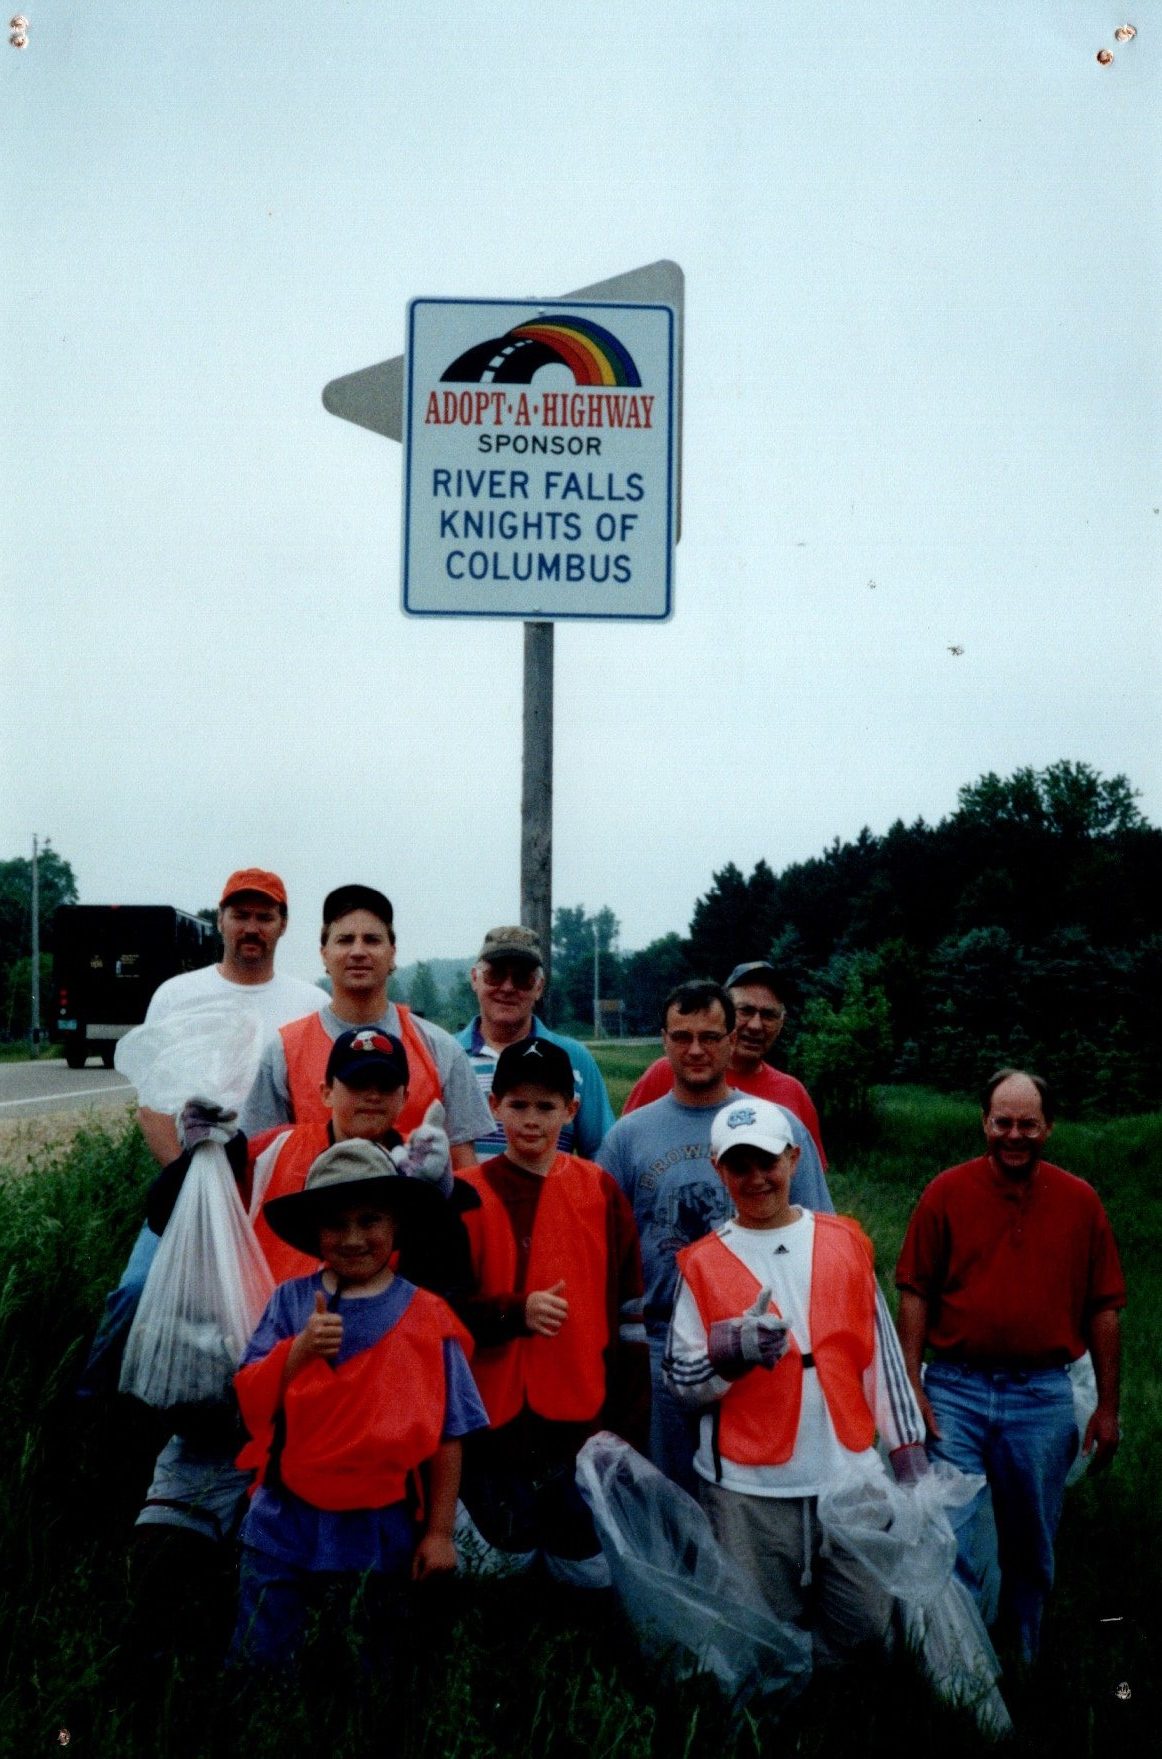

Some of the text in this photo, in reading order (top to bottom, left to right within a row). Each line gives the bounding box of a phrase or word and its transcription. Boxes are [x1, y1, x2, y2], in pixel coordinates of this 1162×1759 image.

[478, 434, 602, 455] SPONSOR
[433, 469, 644, 501] RIVER FALLS
[440, 510, 638, 541] KNIGHTS OF
[446, 551, 631, 583] COLUMBUS
